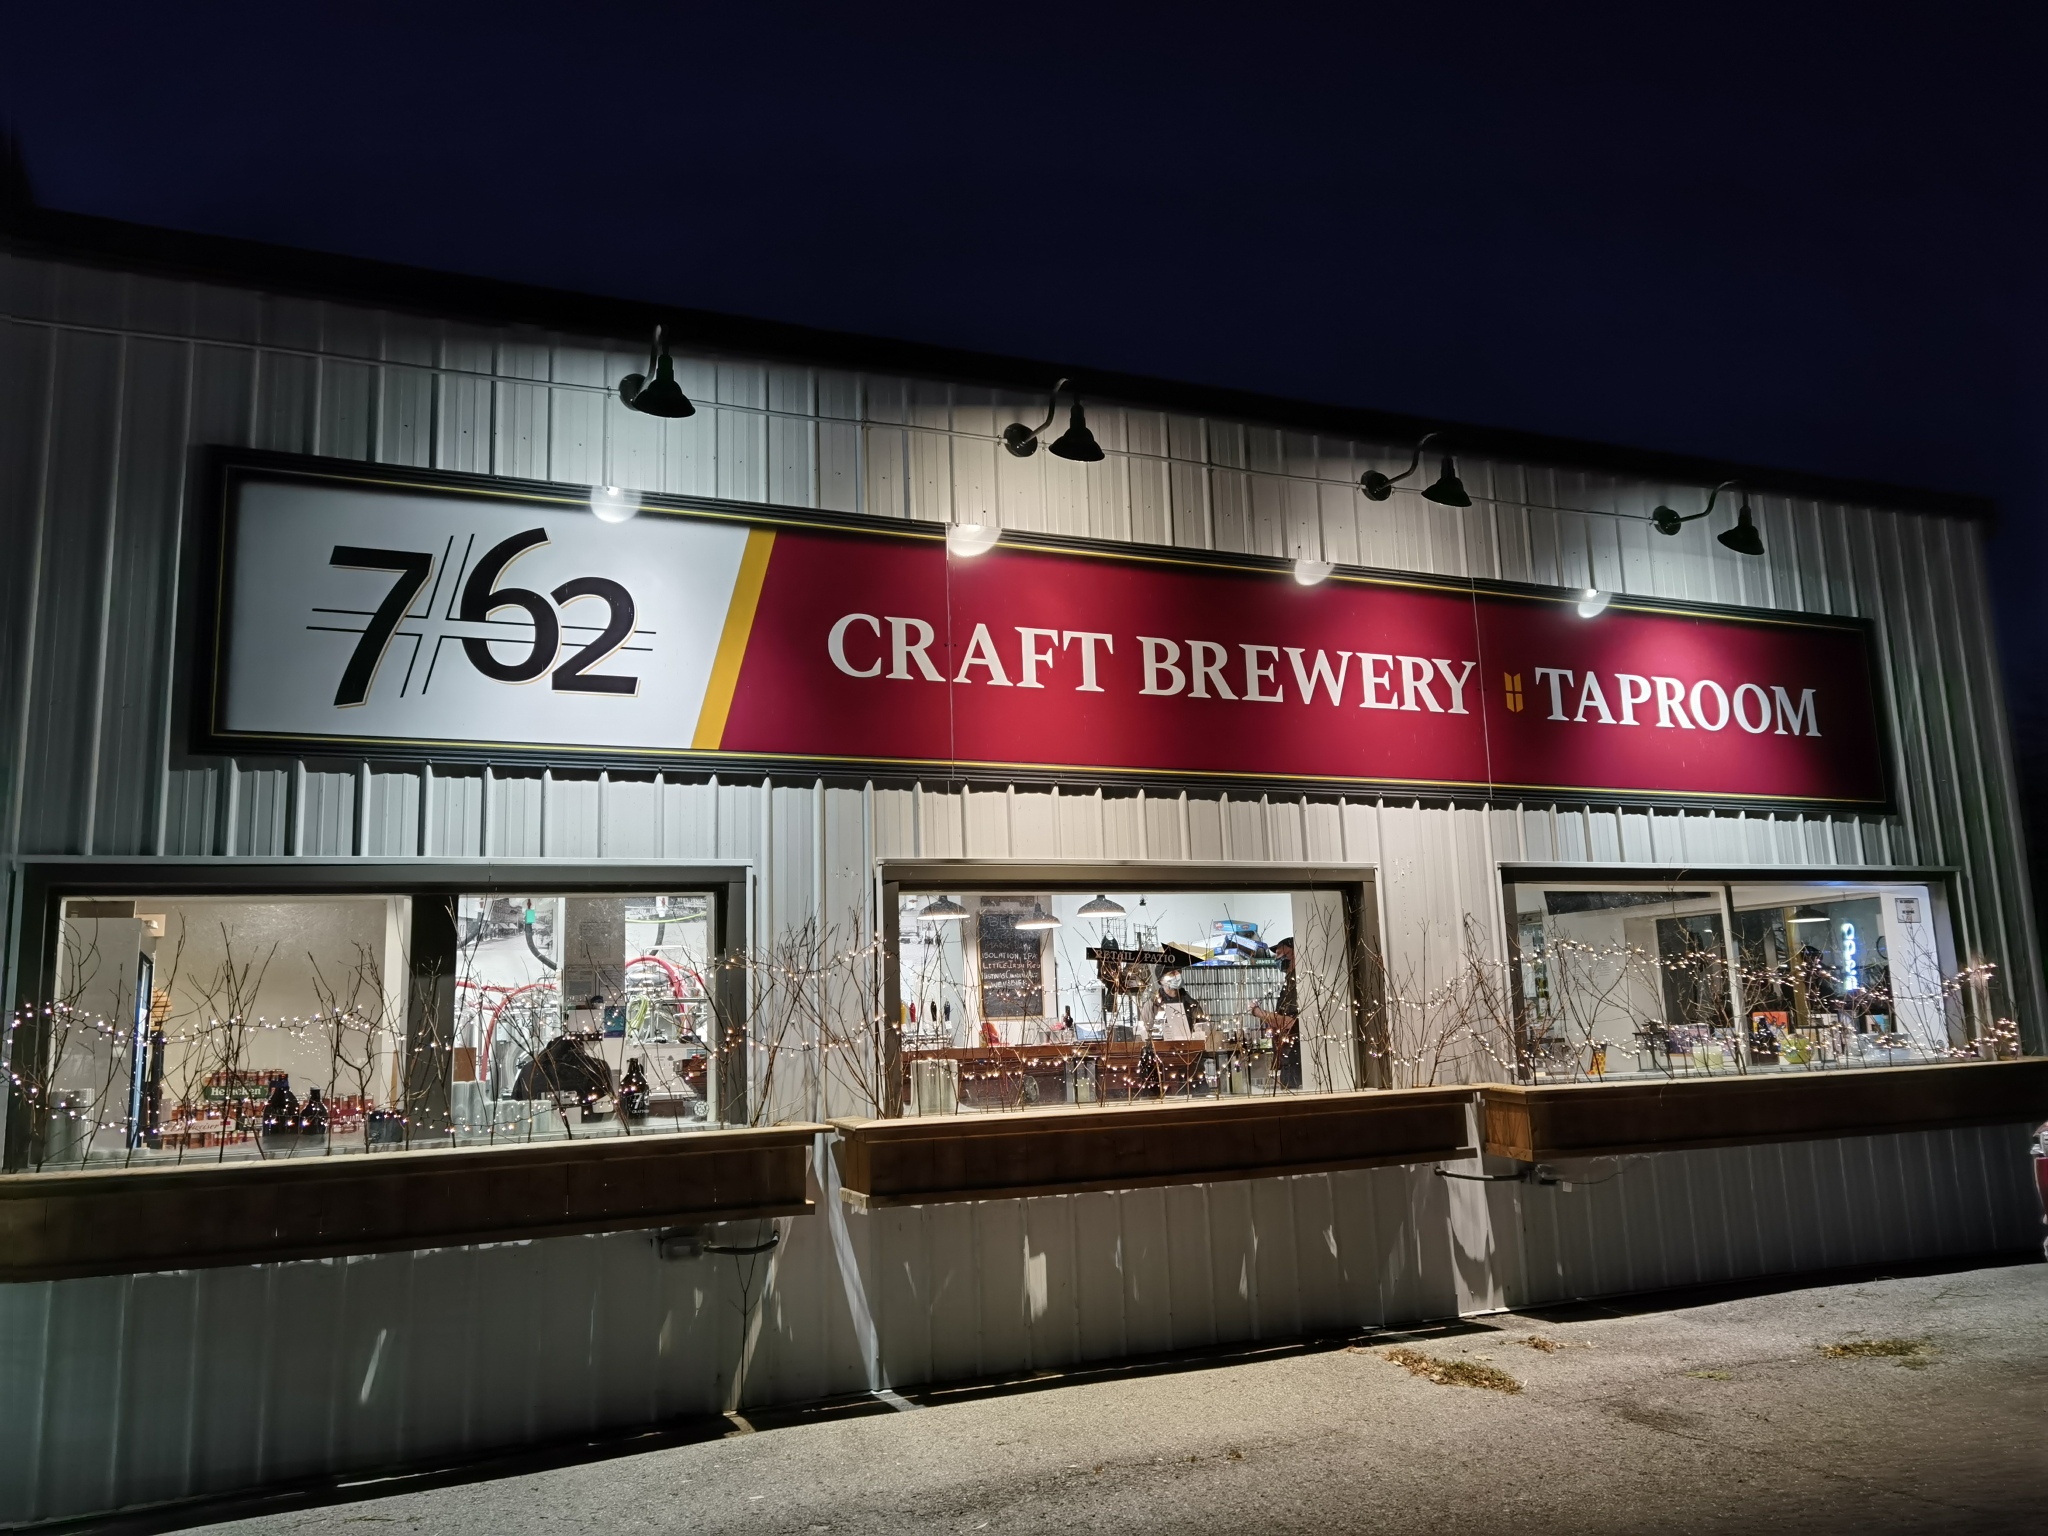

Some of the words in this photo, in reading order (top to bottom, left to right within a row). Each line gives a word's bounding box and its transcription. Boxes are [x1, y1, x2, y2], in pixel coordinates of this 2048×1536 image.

[329, 527, 641, 708] 762
[827, 612, 1114, 692] CRAFT
[1136, 636, 1477, 715] BREWERY
[1535, 667, 1823, 737] TAPROOM
[1095, 949, 1136, 961] RETAIL
[1144, 953, 1176, 963] PATIO
